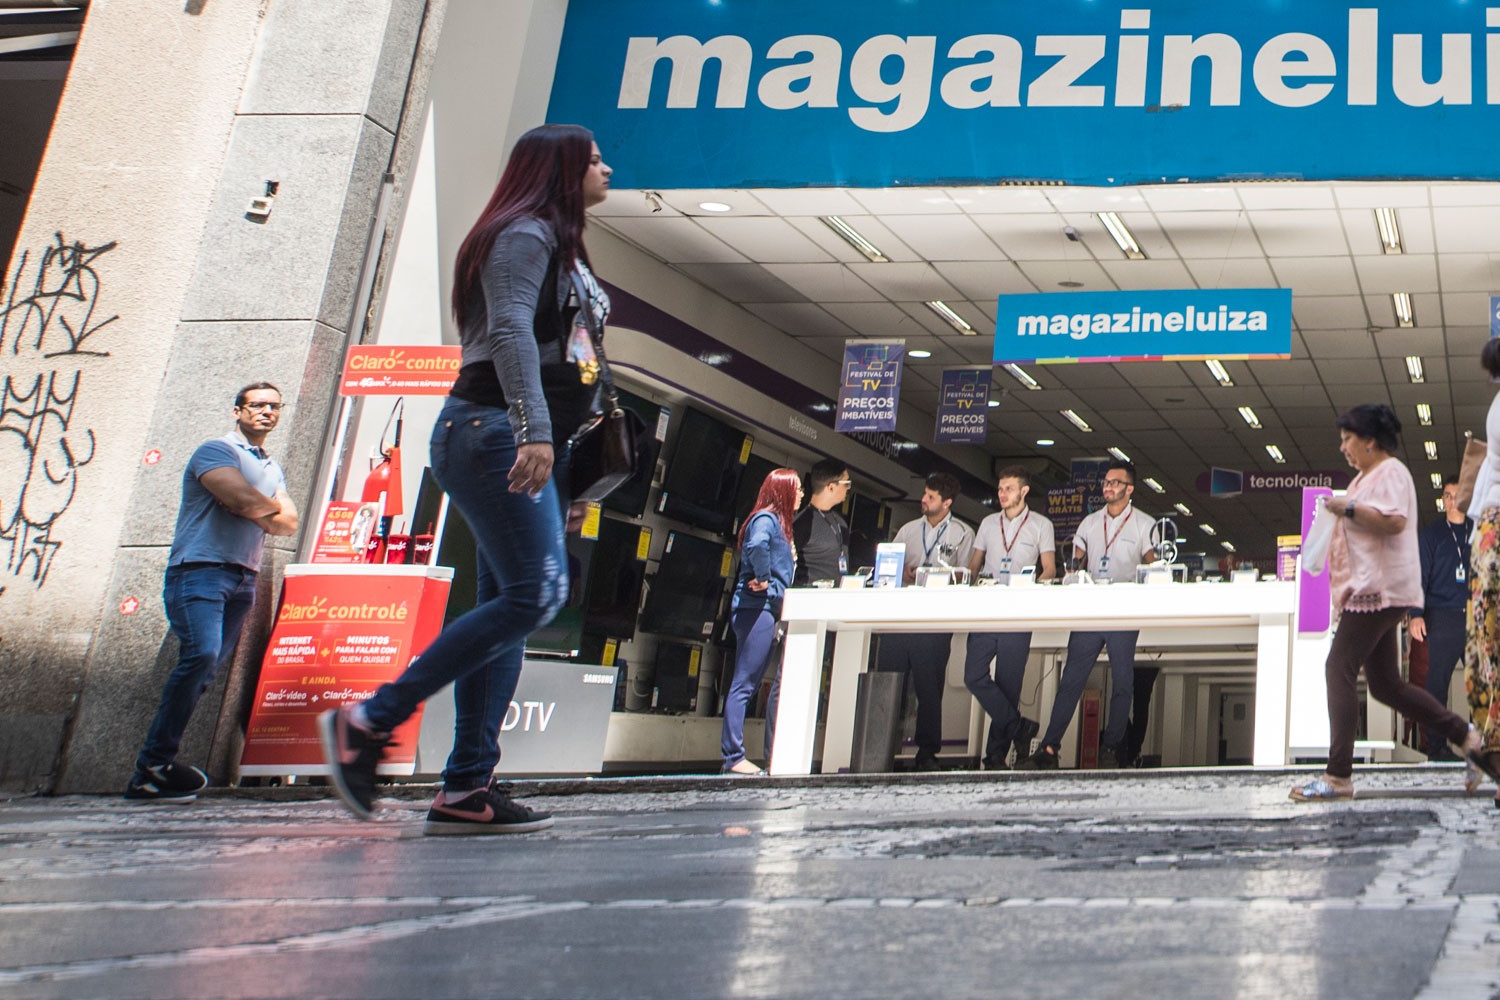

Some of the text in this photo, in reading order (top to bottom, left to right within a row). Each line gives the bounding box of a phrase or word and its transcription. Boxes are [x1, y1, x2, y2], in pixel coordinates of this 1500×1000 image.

[1017, 304, 1268, 341] magazineluiza
[405, 356, 460, 370] contro
[862, 379, 881, 391] TV
[843, 397, 895, 410] PREÇOS
[957, 400, 974, 409] TV
[841, 409, 894, 420] IMBATÍVEIS
[941, 414, 985, 425] PREÇOS
[940, 425, 984, 434] IMBATÍVEIS
[848, 431, 900, 458] ecnologia
[1250, 473, 1333, 489] tecnologia
[1048, 494, 1083, 505] WI-FI
[342, 510, 354, 519] GB
[279, 596, 408, 620] Claro controle
[279, 636, 313, 645] INTERNET
[346, 635, 390, 645] MINUTOS
[272, 644, 316, 656] MAIS RÁPIDA
[335, 646, 397, 655] PARA FALAR COM
[286, 655, 305, 664] BRASIL
[339, 655, 391, 664] QUEM QUISER
[308, 676, 337, 685] AINDA
[582, 674, 614, 685] SAMSUNG
[500, 701, 556, 732] DTV
